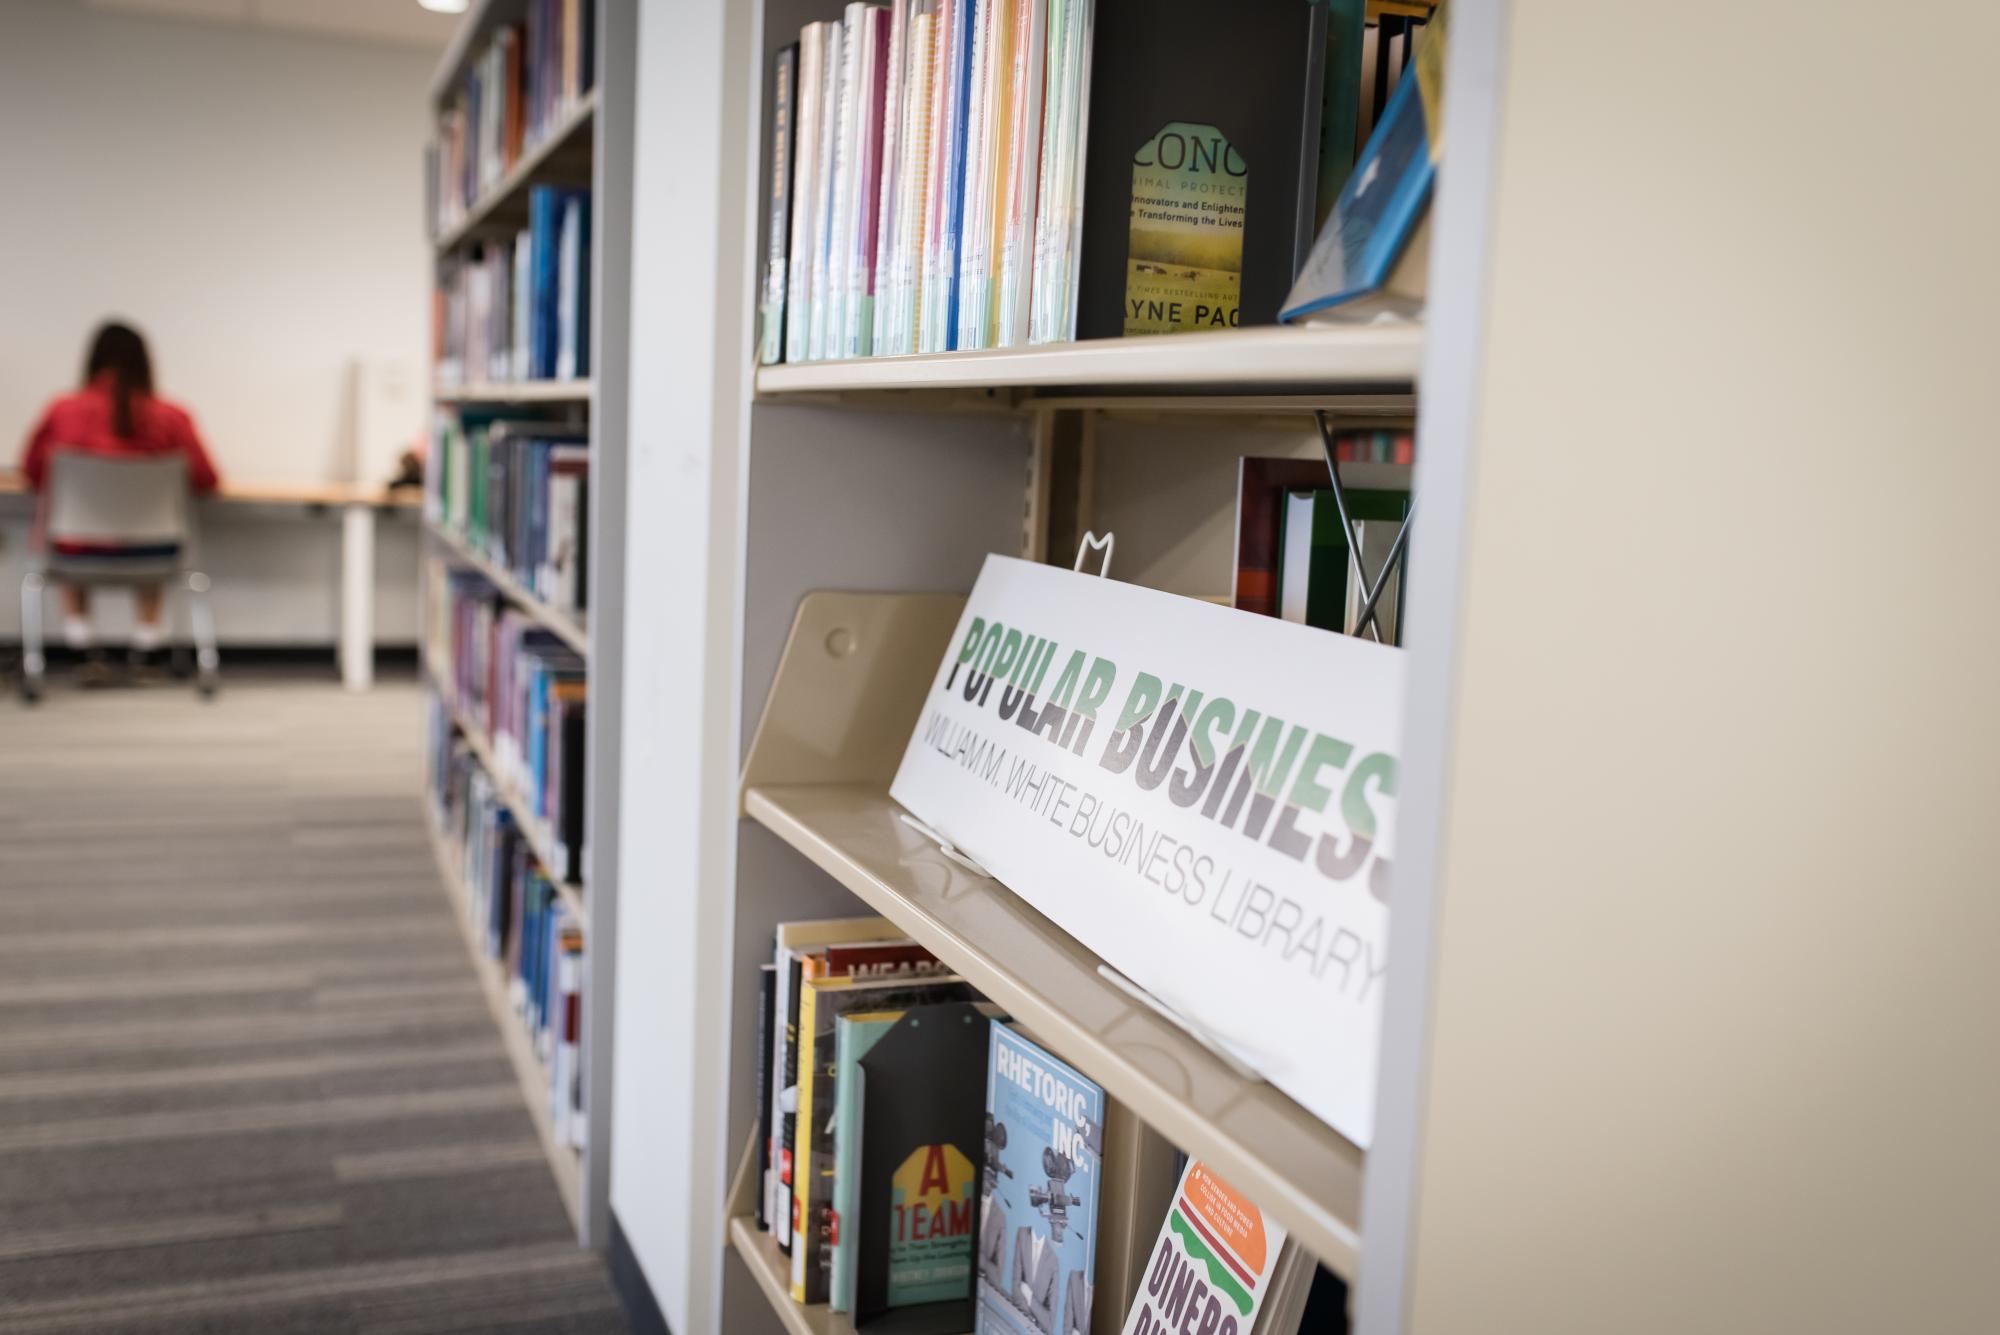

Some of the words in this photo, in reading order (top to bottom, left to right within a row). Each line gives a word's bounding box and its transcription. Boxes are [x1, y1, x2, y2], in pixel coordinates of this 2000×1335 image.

[1138, 209, 1199, 226] Transforming
[1201, 215, 1216, 225] the
[1218, 218, 1243, 228] Lives
[1182, 201, 1199, 210] and
[1201, 202, 1244, 215] Enlighten
[946, 616, 1117, 757] POPULAR
[1099, 671, 1400, 906] BUSINES
[925, 711, 987, 774] WILLIAM
[980, 743, 1006, 787] M.
[1005, 755, 1078, 828] WHITE
[1069, 792, 1215, 906] BUSINESS
[1210, 868, 1392, 1004] LIBRARY
[996, 1041, 1091, 1137] RHETORIC,
[919, 1145, 950, 1196] A
[1053, 1118, 1089, 1173] INC.
[894, 1197, 972, 1242] TEAM
[1214, 1213, 1233, 1237] CULTURE
